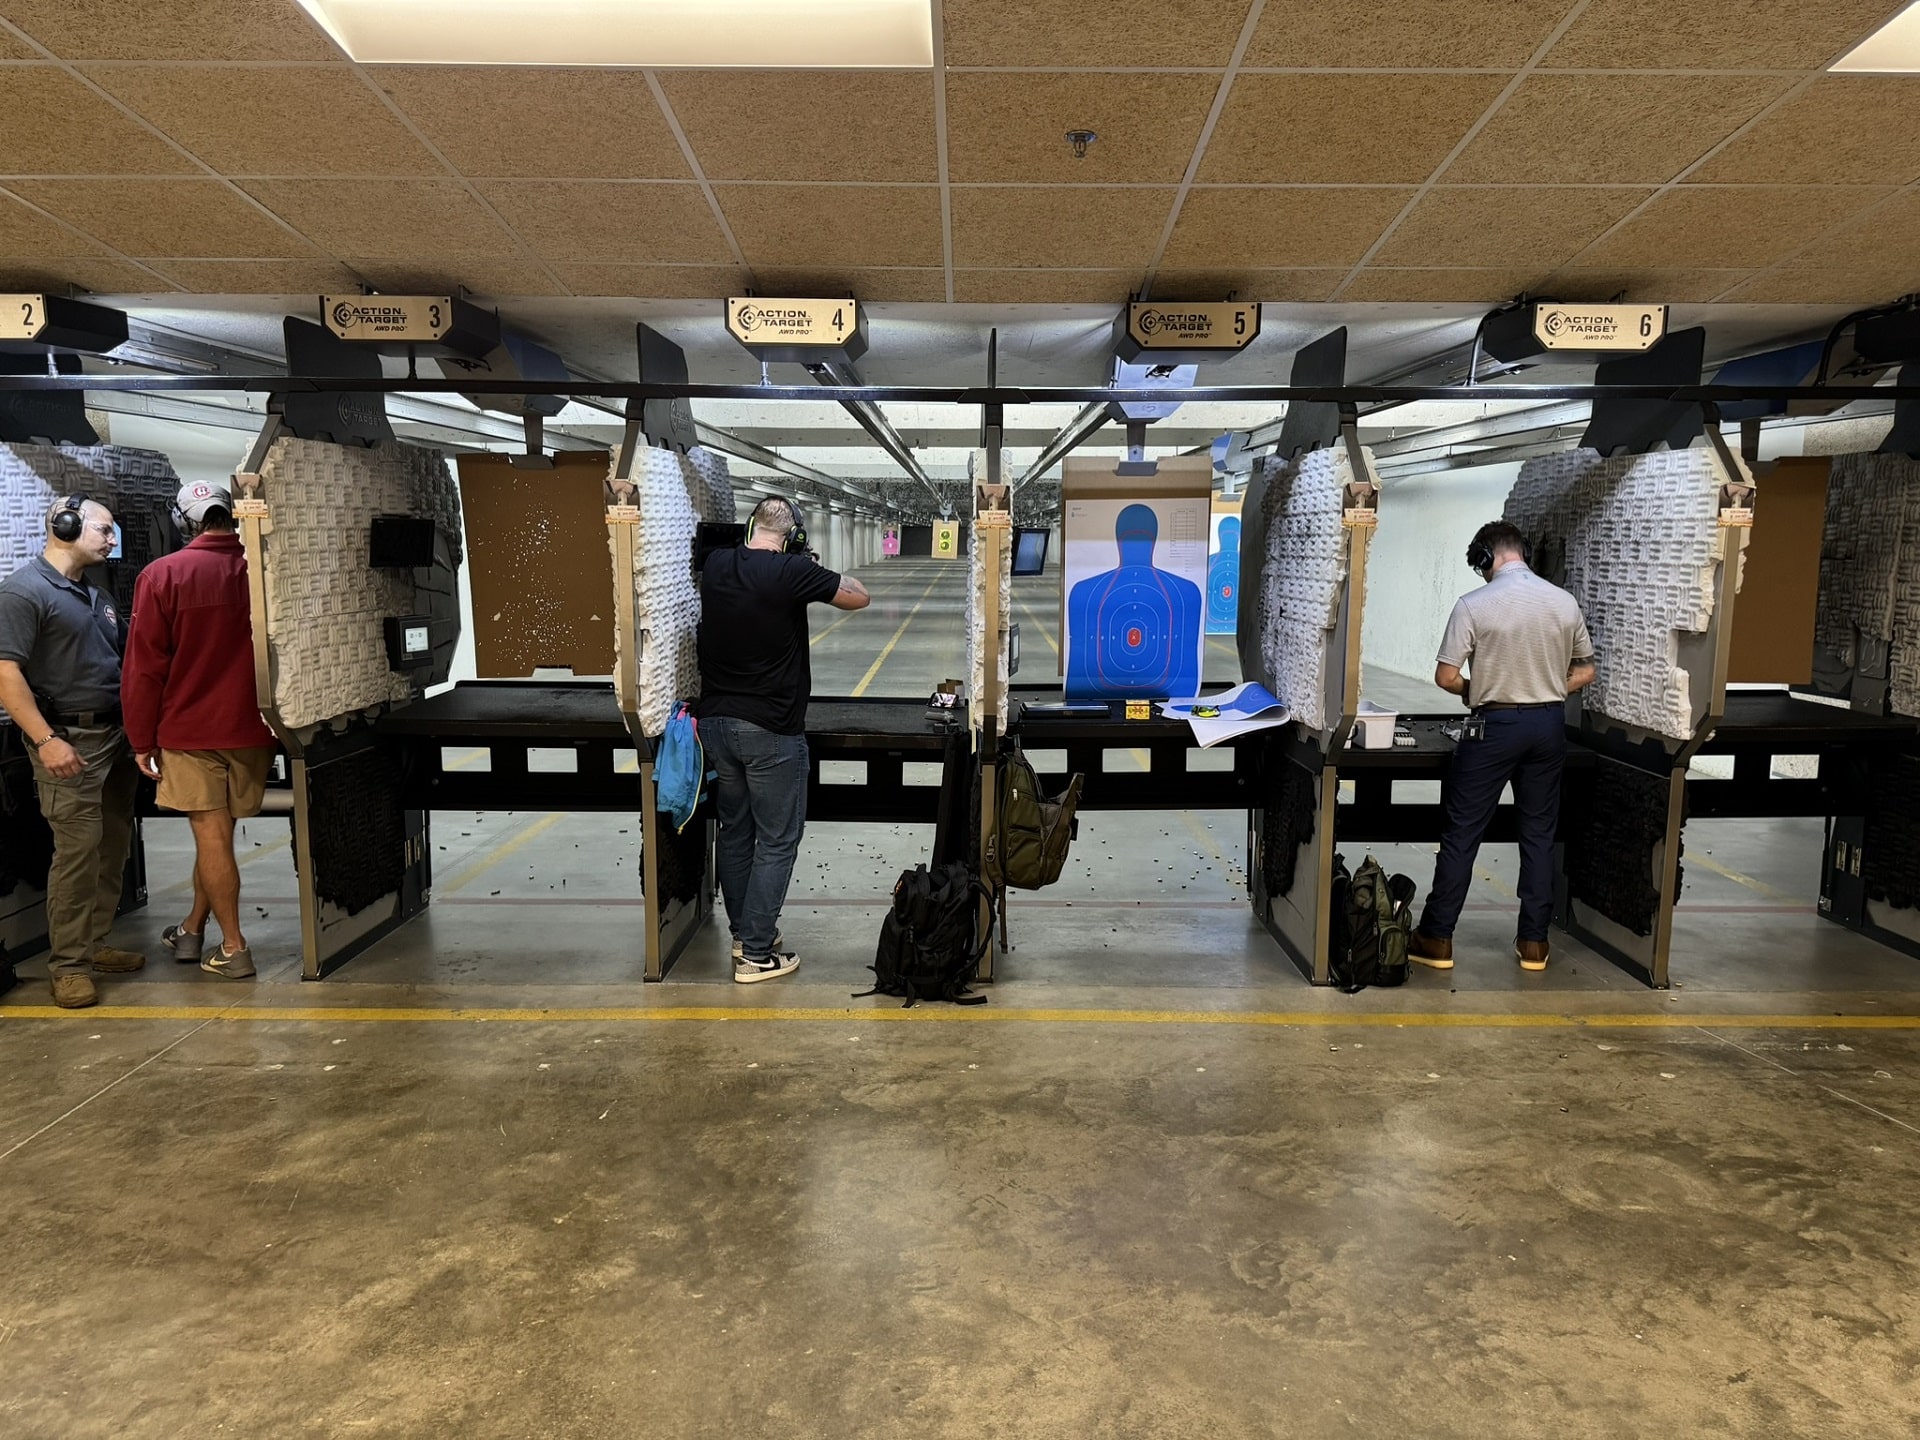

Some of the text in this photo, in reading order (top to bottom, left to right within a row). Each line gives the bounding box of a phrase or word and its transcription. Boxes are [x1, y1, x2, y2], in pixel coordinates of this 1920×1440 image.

[22, 303, 34, 326] 2
[352, 307, 402, 315] ACTION
[756, 310, 807, 318] ACTION
[358, 316, 407, 324] TARGET
[428, 305, 441, 328] 3
[831, 308, 844, 331] 4
[1157, 314, 1208, 322] ACTION
[1563, 316, 1613, 324] ACTION
[763, 319, 813, 327] TARGET
[1163, 323, 1213, 331] TARGET
[1234, 311, 1246, 335] 5
[1639, 313, 1652, 337] 6
[1569, 325, 1618, 333] TARGET
